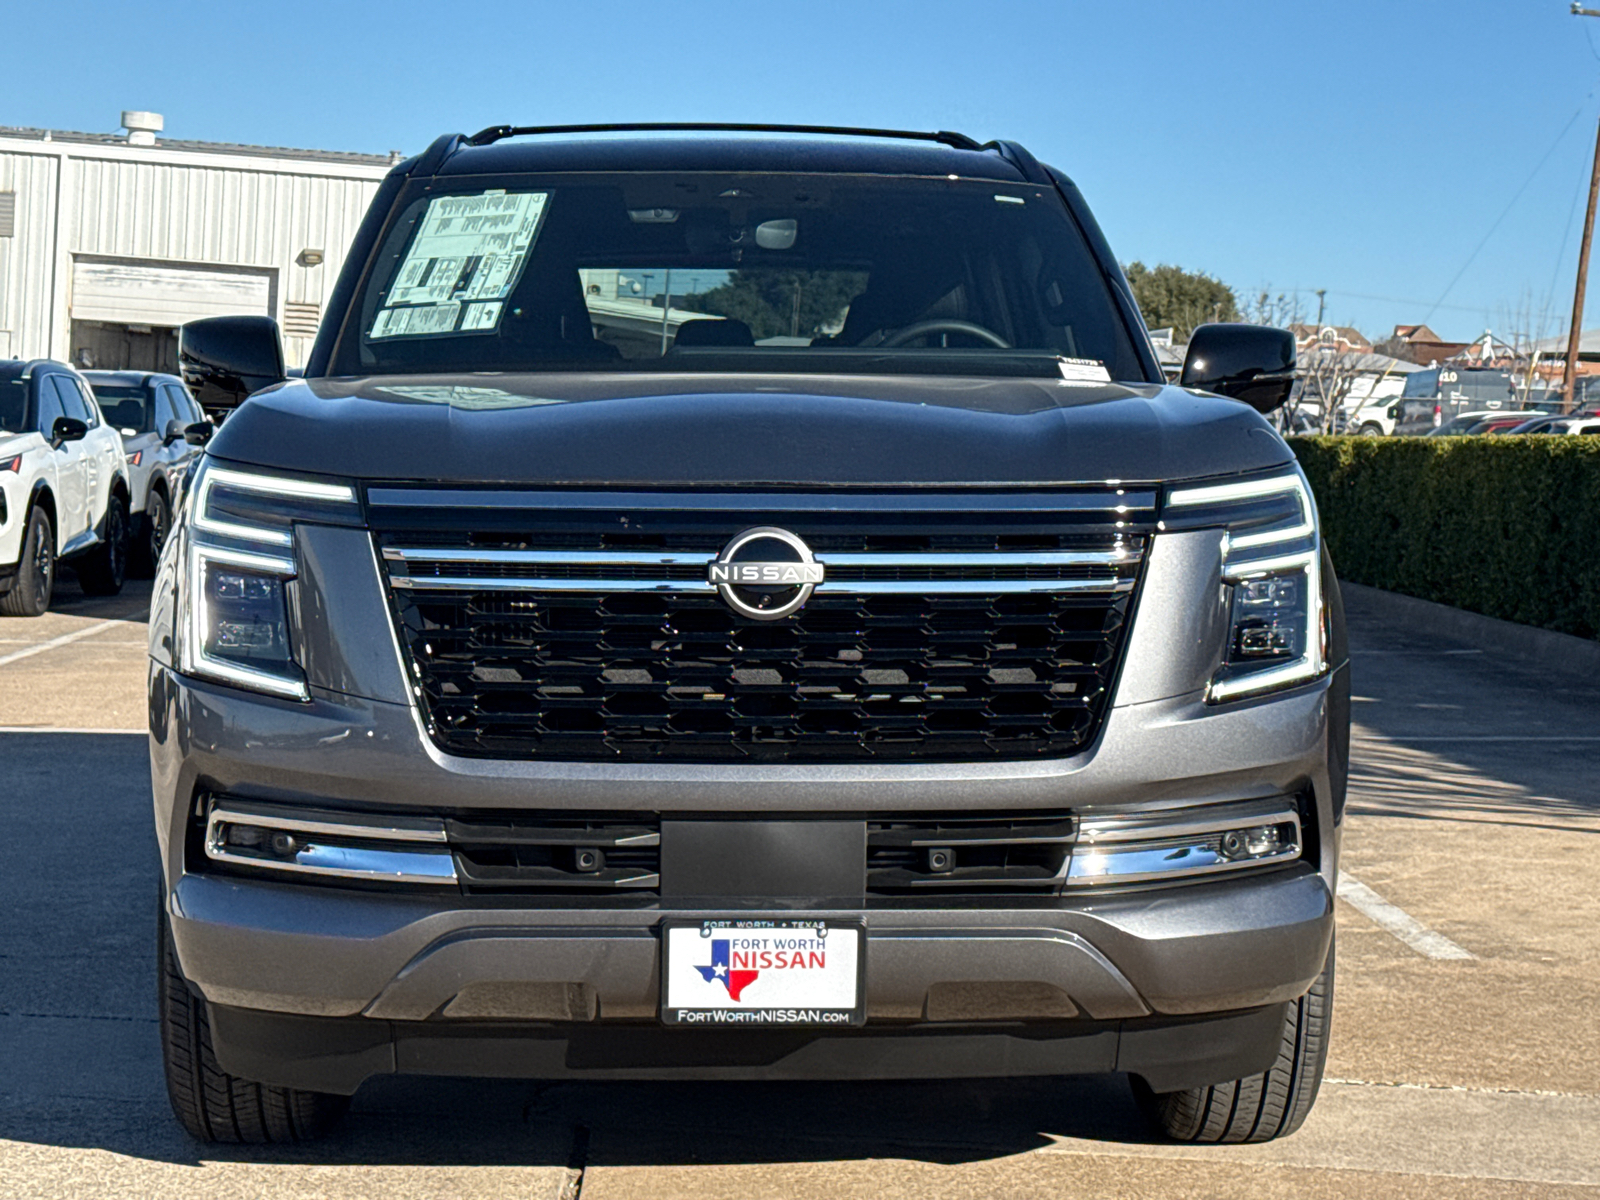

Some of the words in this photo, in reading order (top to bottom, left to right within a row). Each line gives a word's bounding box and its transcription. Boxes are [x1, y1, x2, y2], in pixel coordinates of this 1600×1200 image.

[711, 566, 822, 580] NISSAN
[792, 921, 826, 929] TEXAS
[732, 939, 770, 950] FORT
[774, 939, 826, 950] WORTH
[732, 951, 826, 969] NISSAN
